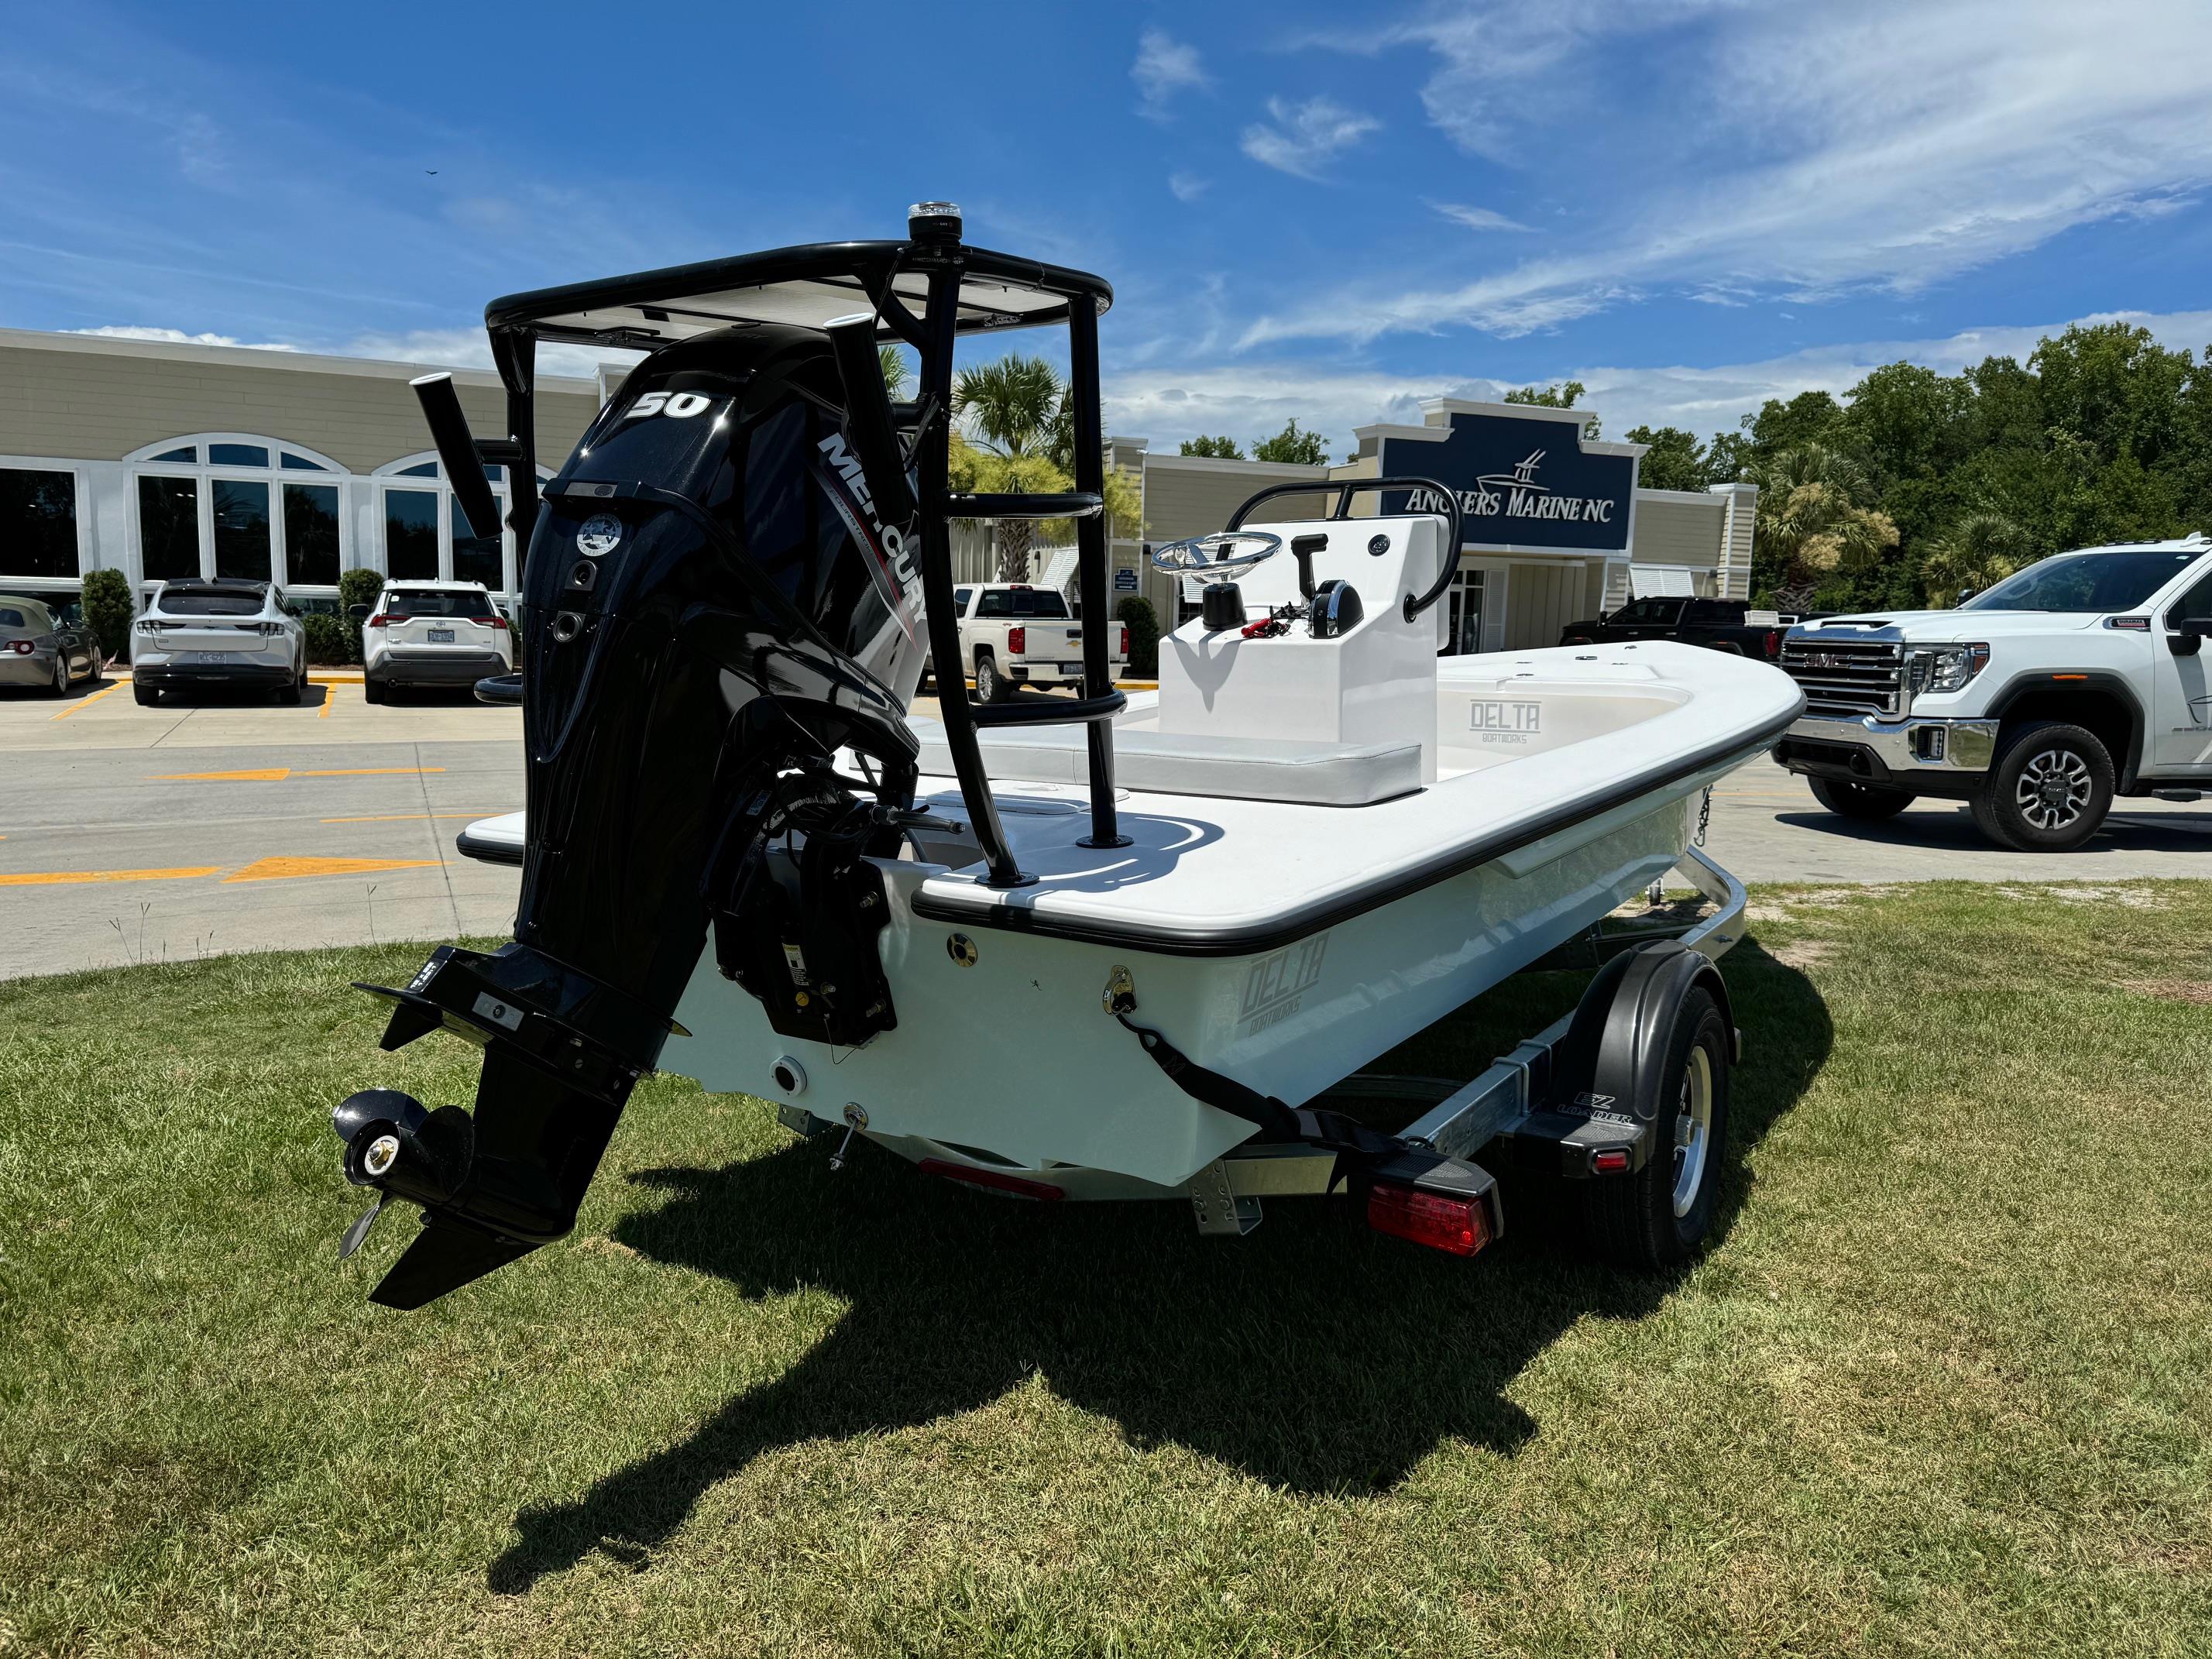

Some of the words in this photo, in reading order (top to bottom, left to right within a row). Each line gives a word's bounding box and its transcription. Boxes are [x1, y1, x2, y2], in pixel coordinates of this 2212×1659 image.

[624, 391, 711, 419] 50
[1505, 488, 1582, 520] MARINE
[1582, 498, 1614, 524] NC
[817, 432, 928, 623] MECURY
[830, 489, 874, 556] FOURSTROK
[1471, 702, 1540, 730] DELTA
[1482, 733, 1527, 744] BOATWORKS
[1242, 931, 1330, 1015] DELTA
[1249, 995, 1302, 1038] BOATWORKS
[1556, 1104, 1633, 1125] LOADER
[1574, 1091, 1616, 1110] EZ
